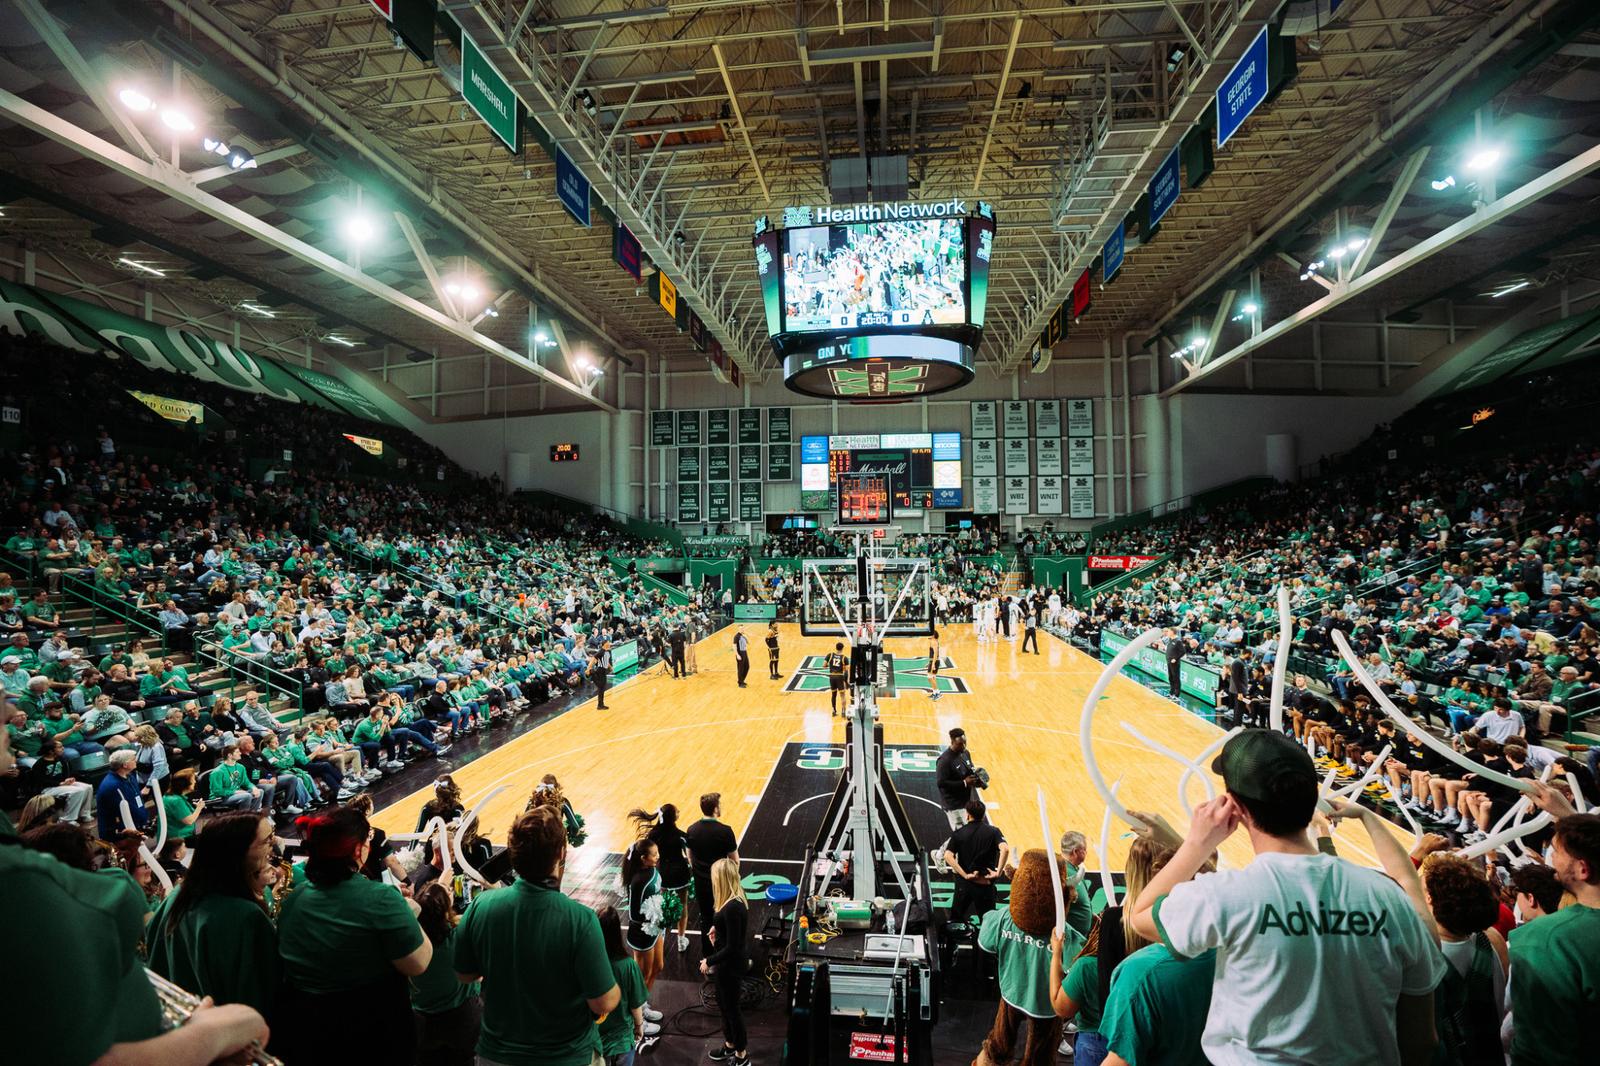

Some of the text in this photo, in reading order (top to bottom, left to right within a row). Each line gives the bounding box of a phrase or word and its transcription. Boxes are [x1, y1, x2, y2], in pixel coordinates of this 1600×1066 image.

[1227, 61, 1256, 104] GEORGIA
[471, 69, 508, 120] MARSHALL
[1231, 82, 1253, 116] STATE
[817, 199, 965, 223] Health Network
[841, 316, 848, 326] 0
[861, 316, 888, 325] 20:00
[902, 313, 910, 322] 0
[818, 346, 836, 360] ON
[160, 403, 192, 415] COLONY
[904, 498, 910, 506] 0
[874, 530, 885, 538] 30
[832, 658, 841, 667] 12
[1258, 901, 1389, 938] Advizex
